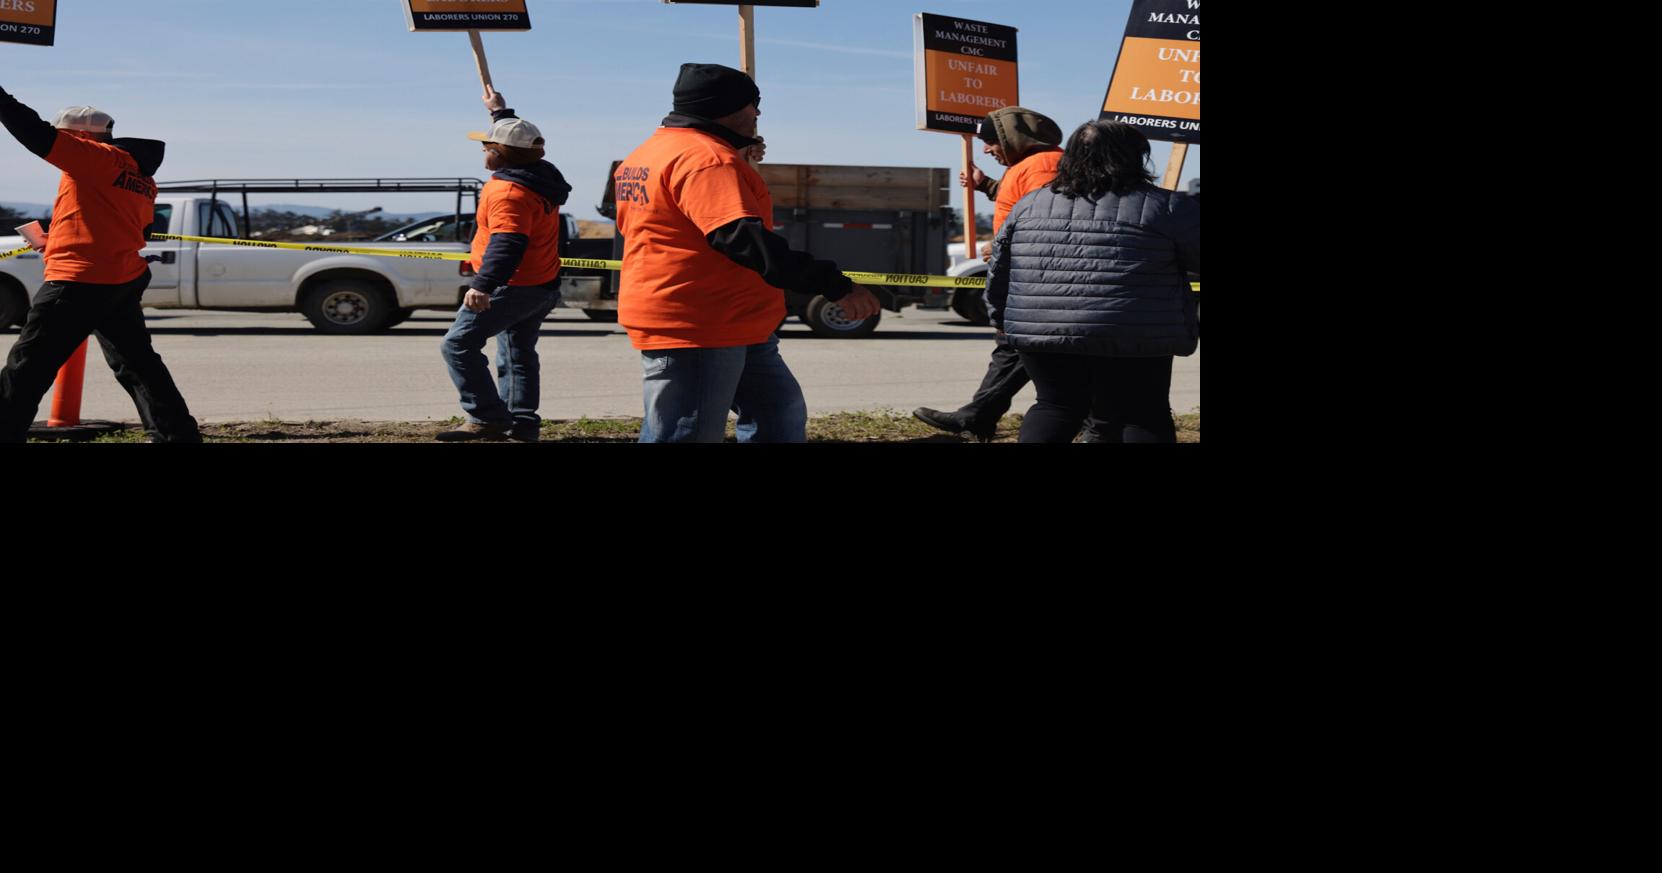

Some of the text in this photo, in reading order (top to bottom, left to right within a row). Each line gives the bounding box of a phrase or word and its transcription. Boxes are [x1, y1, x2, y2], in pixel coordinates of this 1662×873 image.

[20, 25, 41, 35] 270
[954, 21, 989, 34] WASTE
[935, 30, 1007, 48] MANAGEMENT
[960, 46, 984, 56] CMC
[948, 59, 998, 76] UNFAIR
[963, 77, 983, 89] TO
[940, 90, 1007, 108] LABORERS
[935, 114, 973, 125] LABORERS
[1114, 115, 1177, 129] LABORERS
